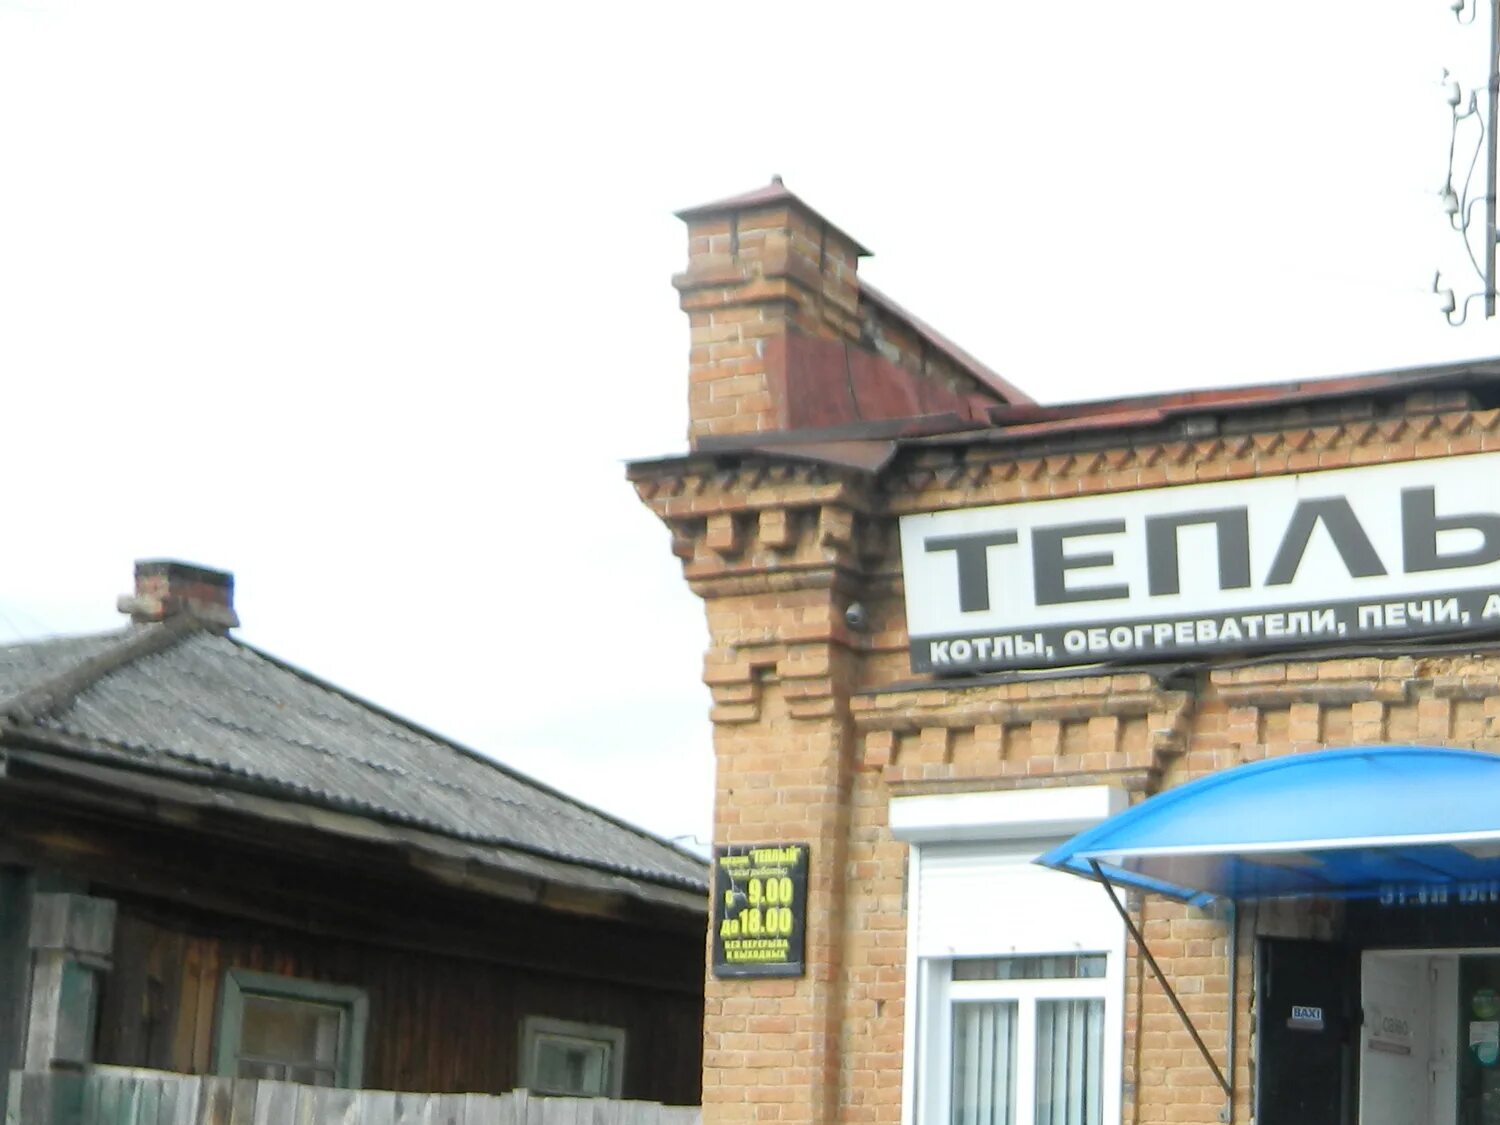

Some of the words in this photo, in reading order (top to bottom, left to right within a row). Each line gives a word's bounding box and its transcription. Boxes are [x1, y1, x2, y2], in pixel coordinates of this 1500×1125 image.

[929, 635, 1054, 664] КОТЛЫ,
[1063, 608, 1346, 653] ОБОГРЕВАТЕЛИ,
[1358, 597, 1470, 628] ПЕЧИ,
[748, 877, 793, 905] 9.00
[739, 907, 793, 936] 18.00
[725, 939, 741, 950] БЕЗ
[743, 938, 789, 949] ПЕРЕРЫВА
[1294, 1008, 1320, 1019] BAXI
